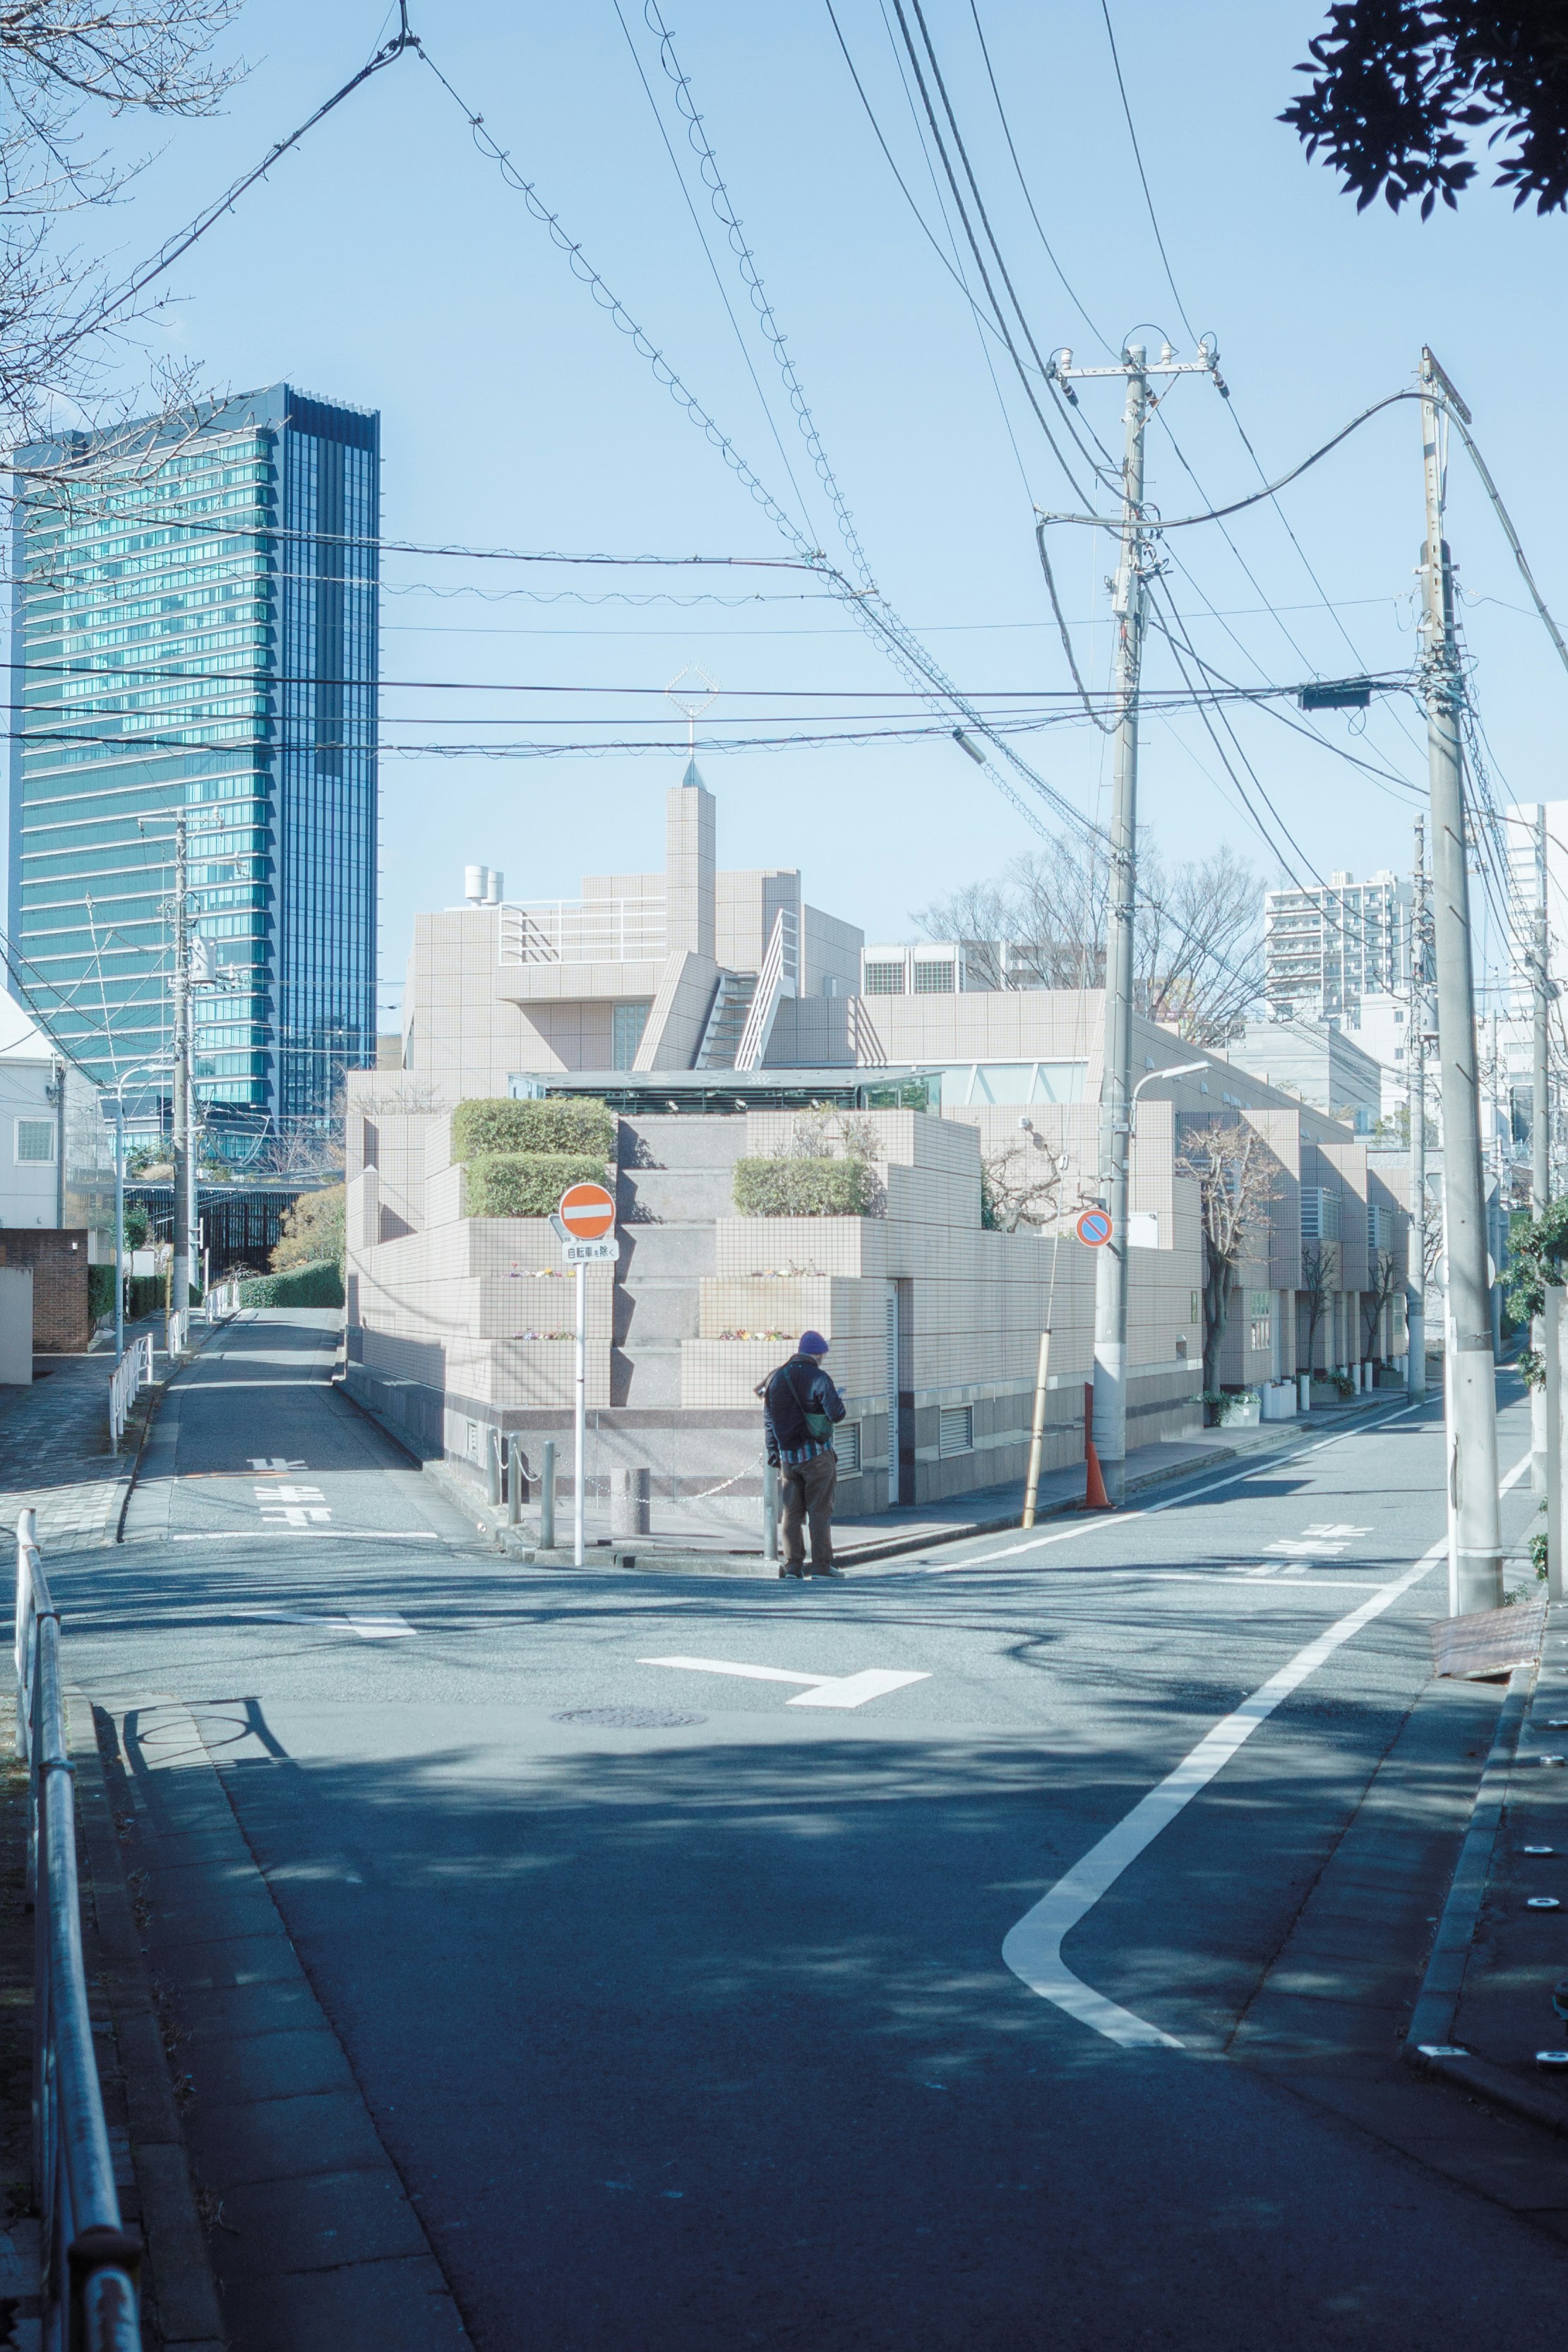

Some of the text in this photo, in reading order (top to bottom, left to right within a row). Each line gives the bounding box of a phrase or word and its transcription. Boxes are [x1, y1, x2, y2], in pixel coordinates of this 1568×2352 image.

[568, 1246, 614, 1259] 自転車を除く
[246, 1458, 333, 1527] 止まれ
